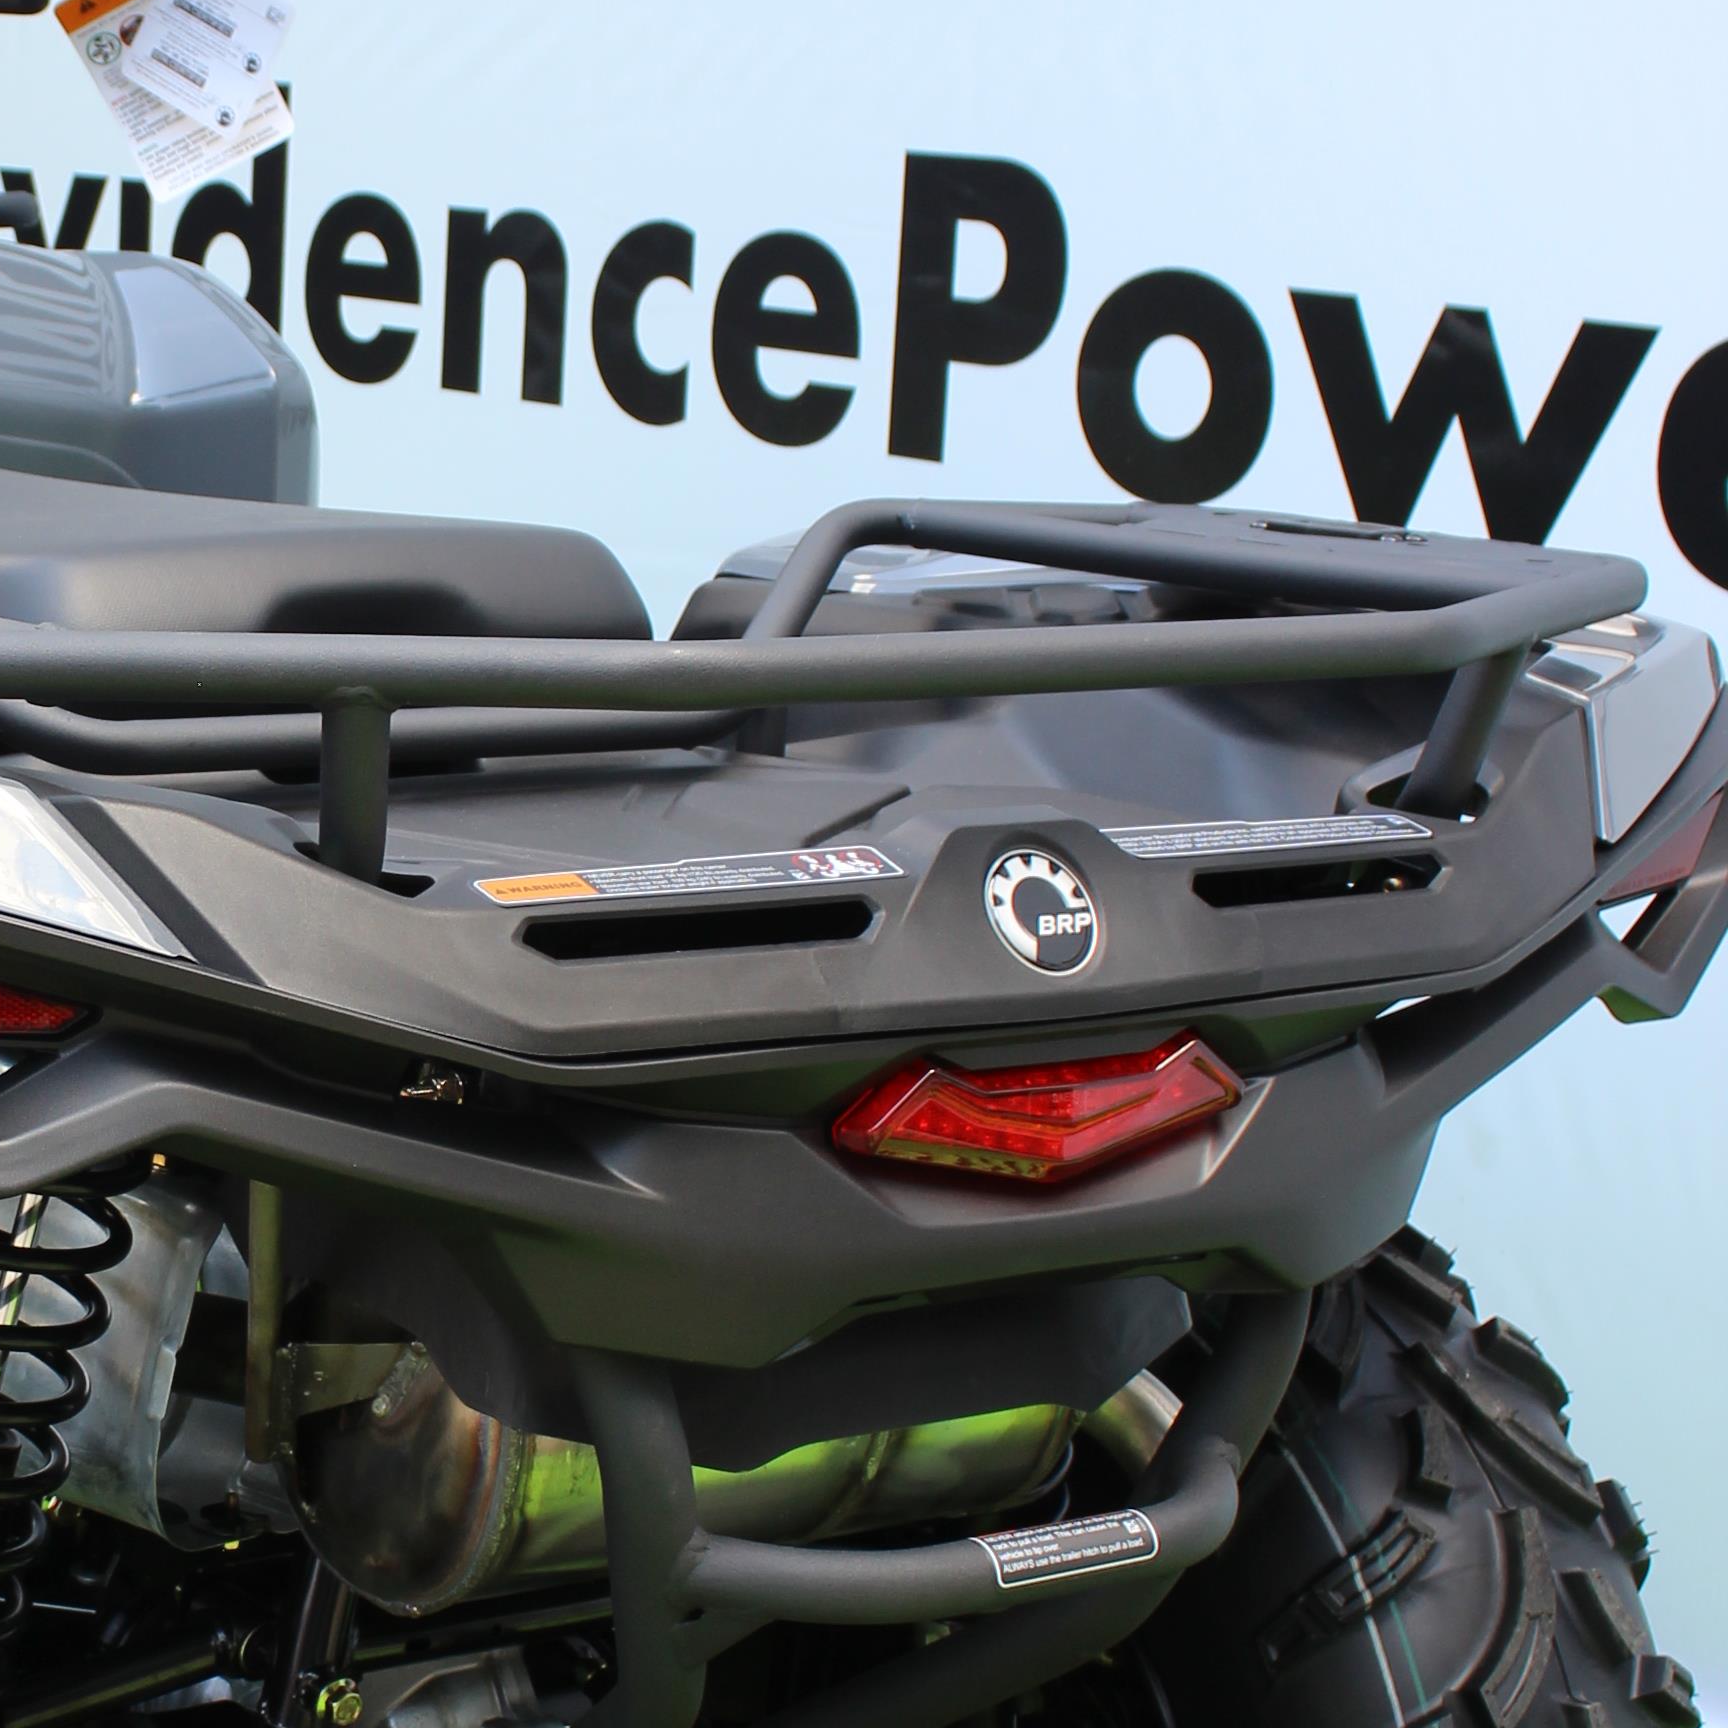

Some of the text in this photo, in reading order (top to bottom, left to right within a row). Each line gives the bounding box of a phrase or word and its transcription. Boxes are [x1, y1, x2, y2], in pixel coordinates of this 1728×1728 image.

[506, 881, 583, 893] WARNING
[1038, 912, 1092, 936] BRP
[1003, 1558, 1035, 1573] ALWAYS
